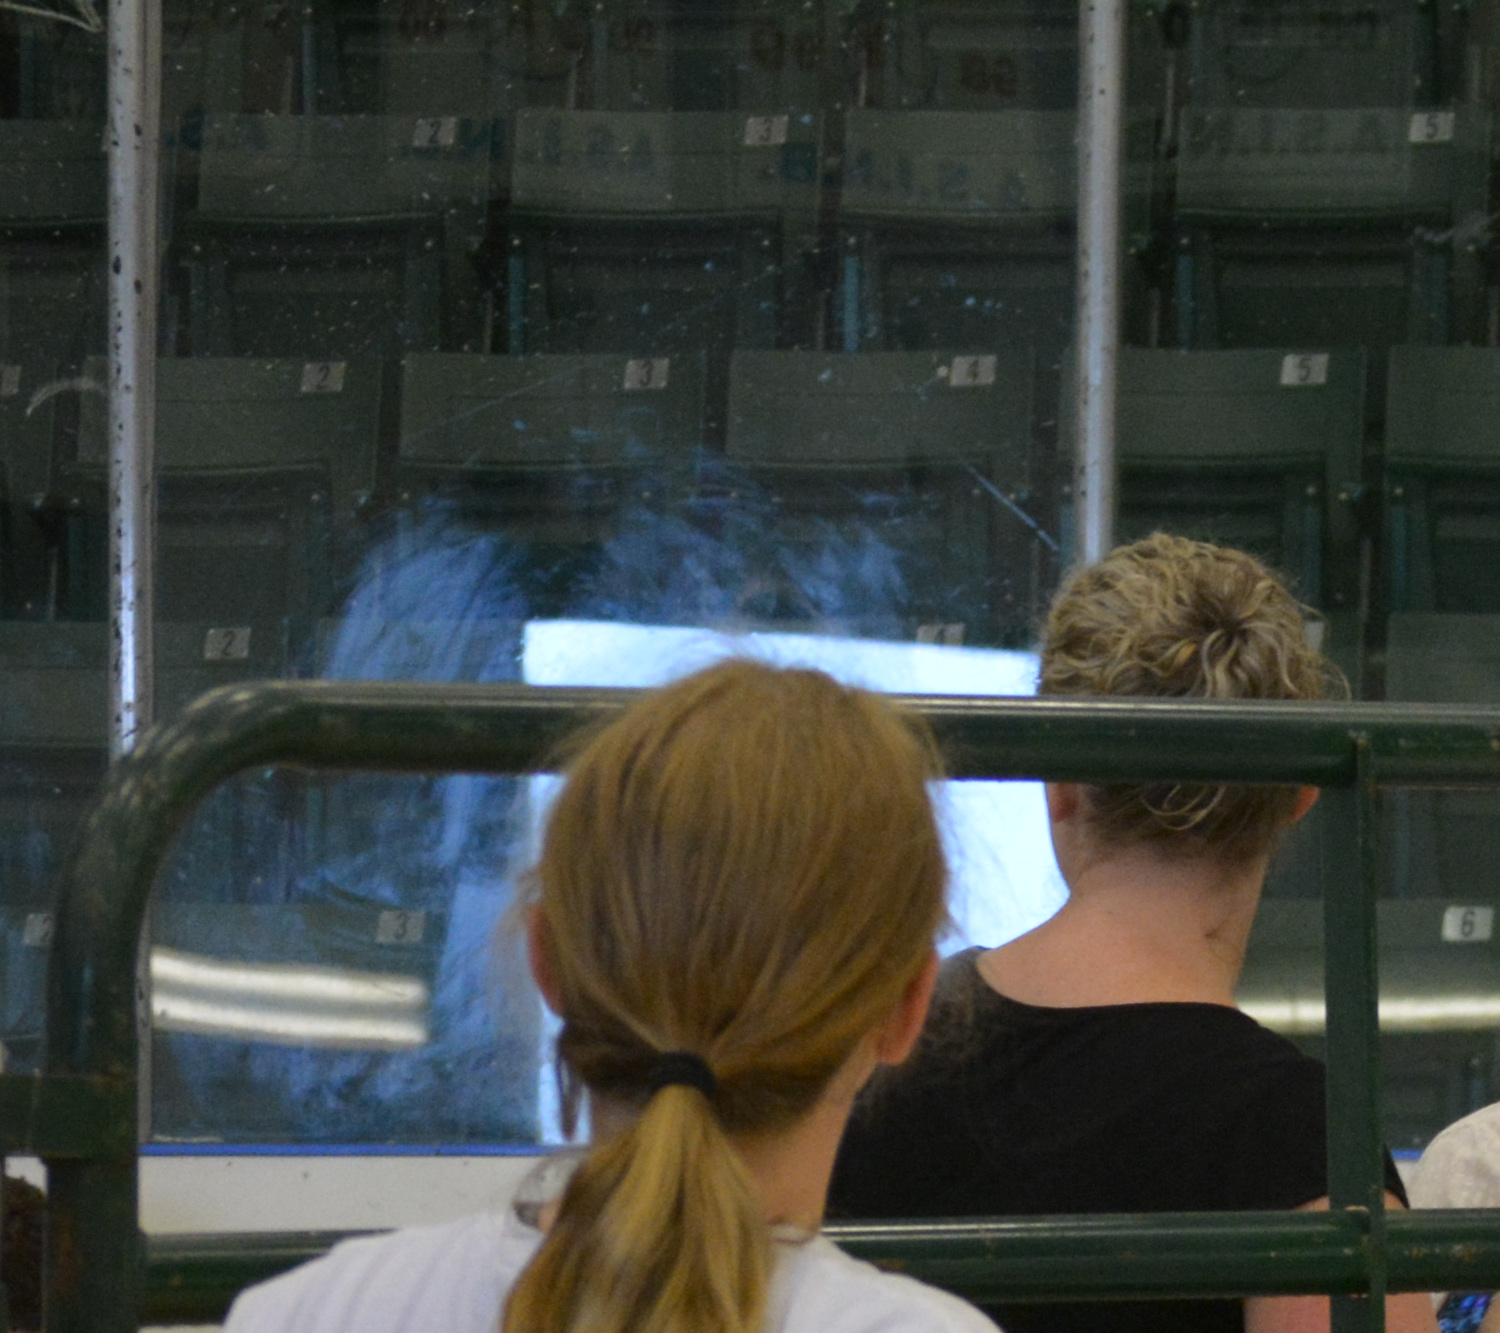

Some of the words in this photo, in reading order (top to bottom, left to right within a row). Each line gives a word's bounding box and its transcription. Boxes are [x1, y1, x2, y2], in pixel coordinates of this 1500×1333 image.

[429, 118, 442, 145] 2
[758, 117, 772, 142] 3
[1426, 113, 1439, 139] 5
[316, 364, 330, 391] 2
[638, 360, 652, 388] 3
[966, 359, 980, 383] 4
[1299, 355, 1312, 381] 5
[222, 630, 236, 657] 2
[393, 911, 409, 940] 3
[1460, 909, 1475, 939] 6
